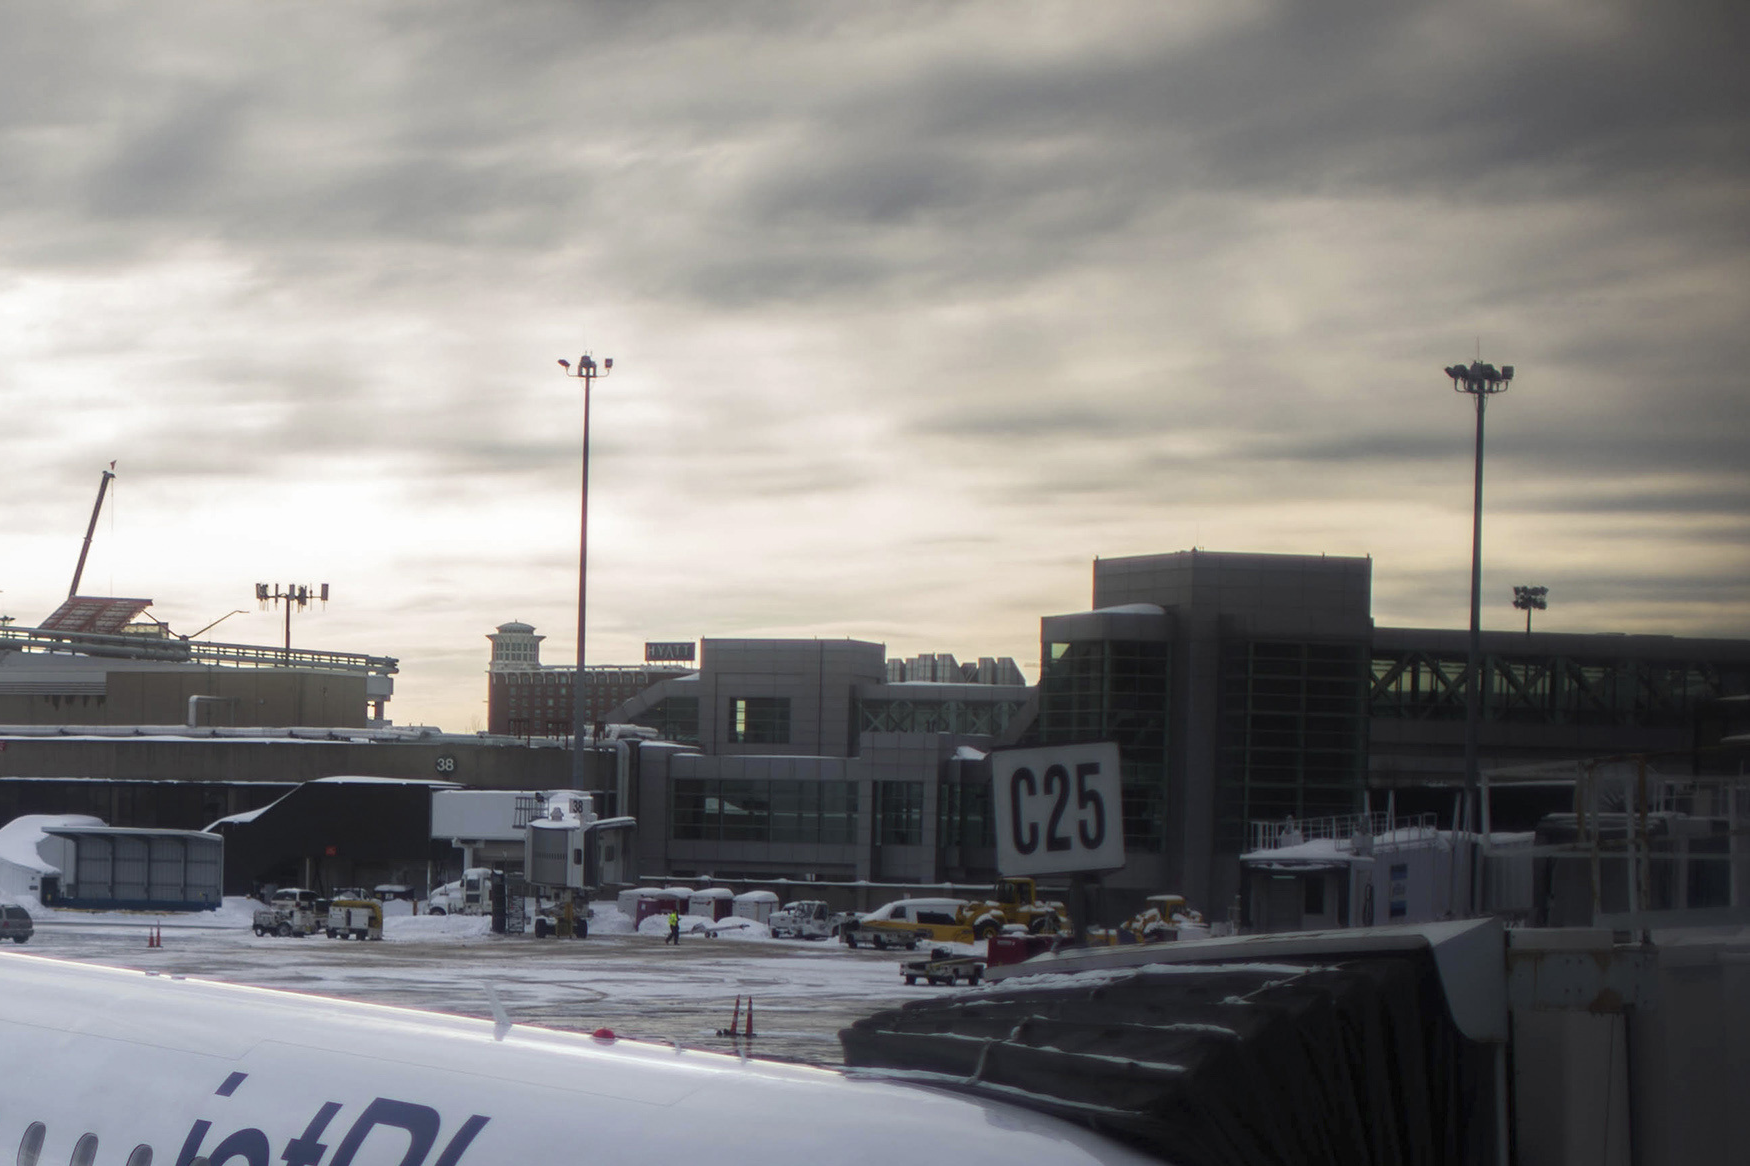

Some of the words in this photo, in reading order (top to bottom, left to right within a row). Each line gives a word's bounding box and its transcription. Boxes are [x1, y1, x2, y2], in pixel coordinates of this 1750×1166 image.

[646, 644, 690, 659] HYATT
[436, 757, 454, 772] 38
[572, 800, 584, 813] 38
[1010, 761, 1106, 856] C25
